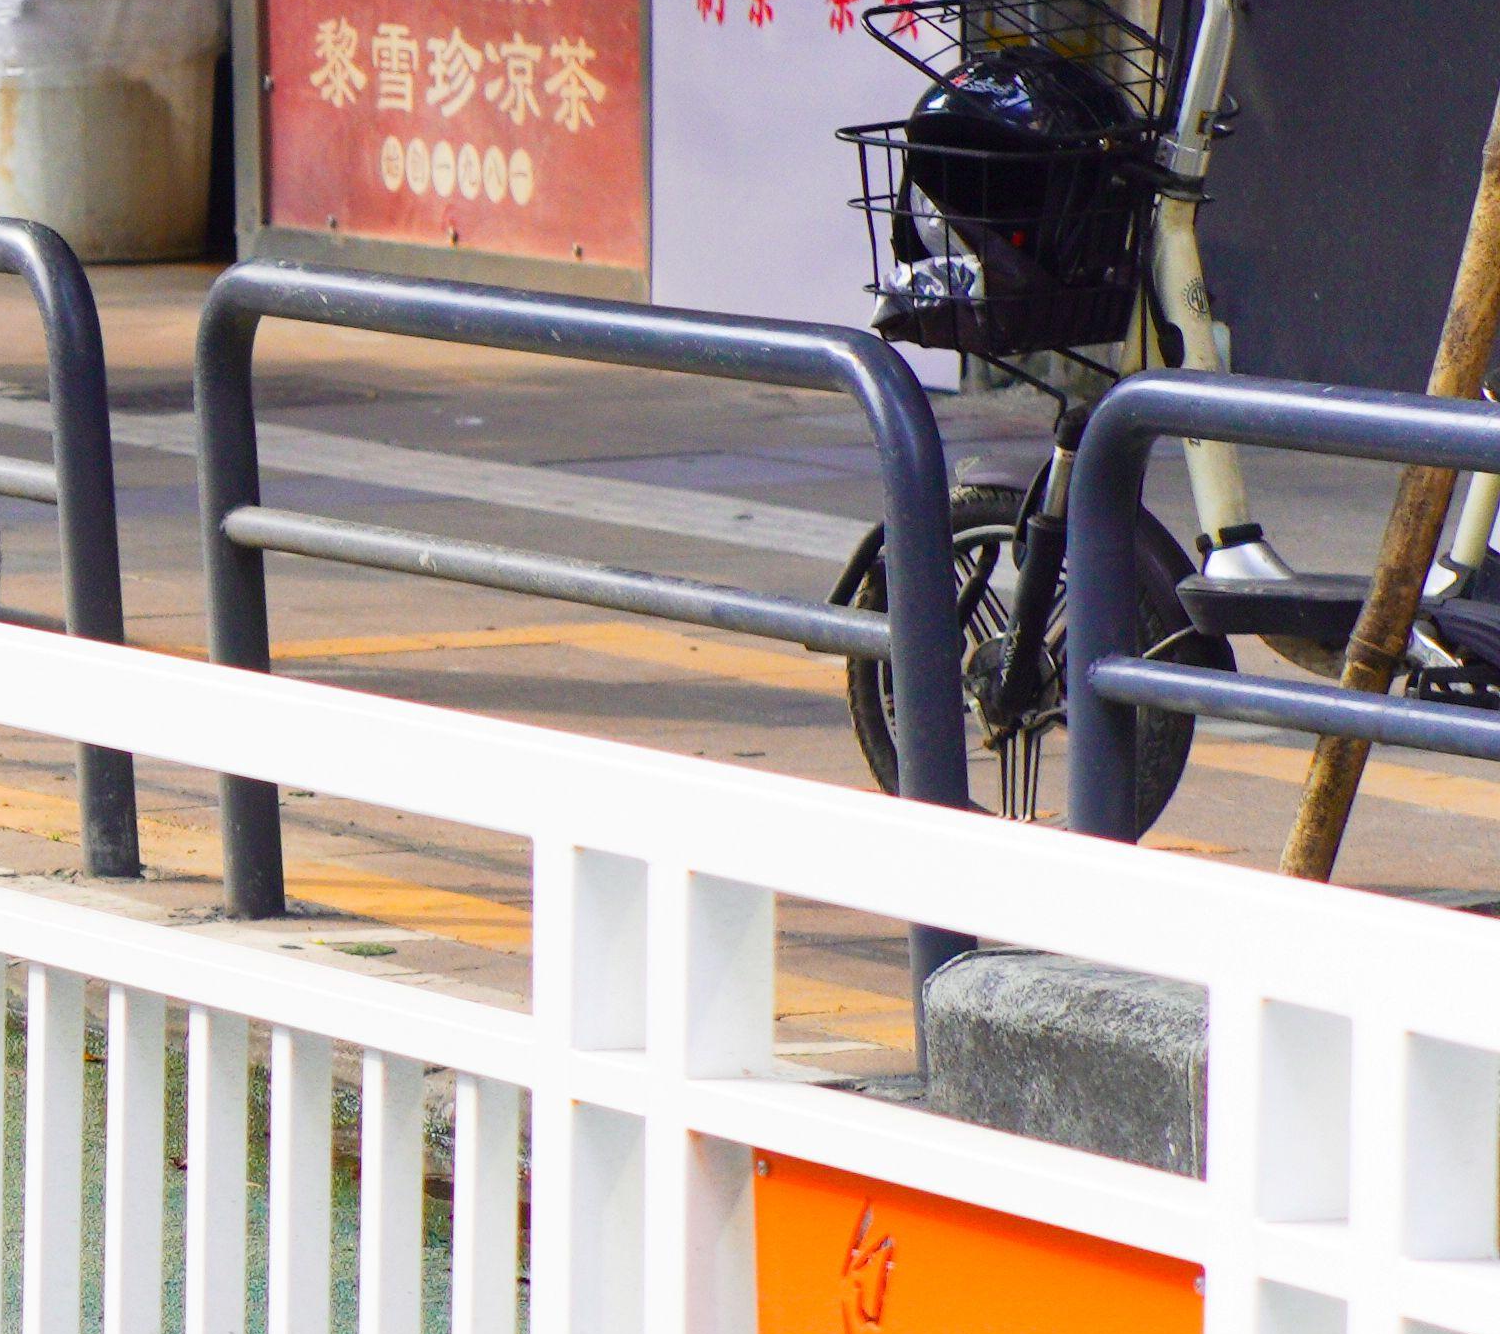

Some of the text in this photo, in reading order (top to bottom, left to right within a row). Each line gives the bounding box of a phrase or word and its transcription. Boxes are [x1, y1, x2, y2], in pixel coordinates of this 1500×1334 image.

[308, 16, 608, 134] 黎雪珍凉茶
